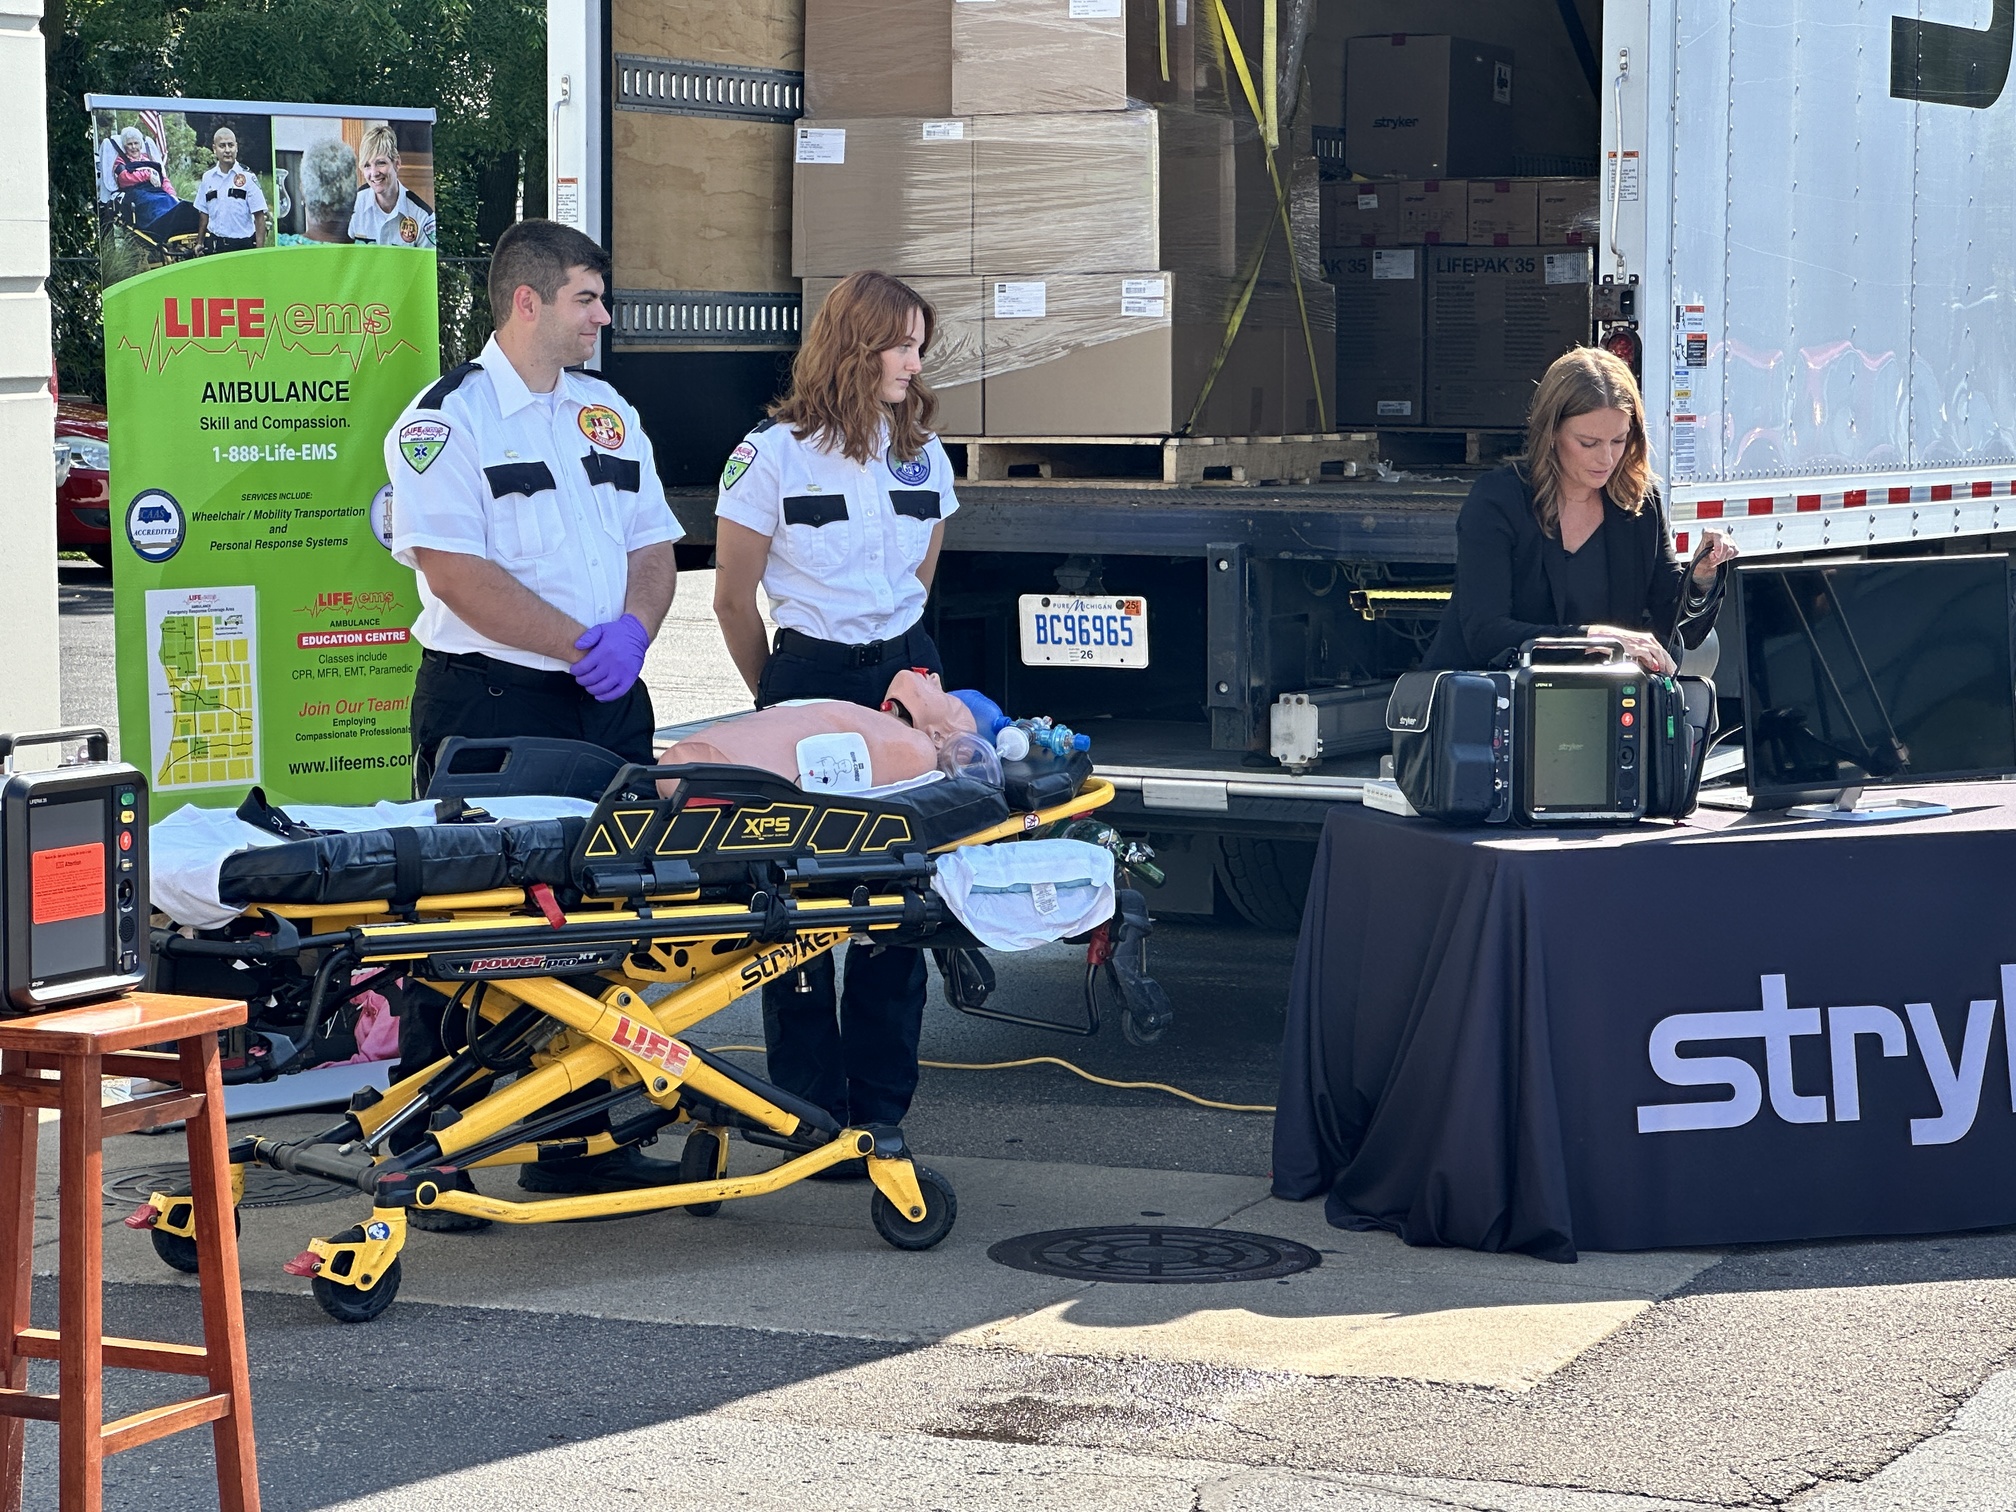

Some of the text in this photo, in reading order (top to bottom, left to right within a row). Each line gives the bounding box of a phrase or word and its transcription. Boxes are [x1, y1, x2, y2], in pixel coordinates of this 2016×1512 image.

[1372, 115, 1419, 130] stryker
[1347, 257, 1367, 274] 35
[1515, 257, 1536, 273] 35
[164, 297, 393, 338] LIFE ems
[200, 380, 350, 404] AMBULANCE
[200, 415, 351, 432] Skill and Compassion.
[212, 443, 337, 463] 1-888-Life-EMS
[241, 491, 313, 501] SERVICES INCLUDE:
[192, 509, 246, 522] Wheelchair
[253, 508, 292, 521] Mobility
[294, 506, 366, 520] Transportation
[134, 528, 178, 536] ACCREDITED
[269, 524, 288, 534] and
[210, 537, 349, 551] Personal Response Systems
[318, 591, 394, 607] LIFE ems
[1067, 599, 1112, 613] MICHIGAN
[1126, 600, 1136, 610] 25
[330, 618, 381, 628] AMBULANCE
[1034, 614, 1133, 646] BC96965
[302, 630, 406, 646] EDUCATION CENTRE
[318, 651, 388, 665] Classes include
[1080, 650, 1093, 660] 26
[292, 663, 414, 681] CPR, MFR, EMT, Paramedic
[298, 695, 410, 717] Join Our Team!
[332, 716, 377, 728] Employing
[295, 729, 358, 742] Compassionate
[742, 816, 791, 837] XPS
[469, 955, 547, 973] power
[610, 1014, 692, 1077] LIFE
